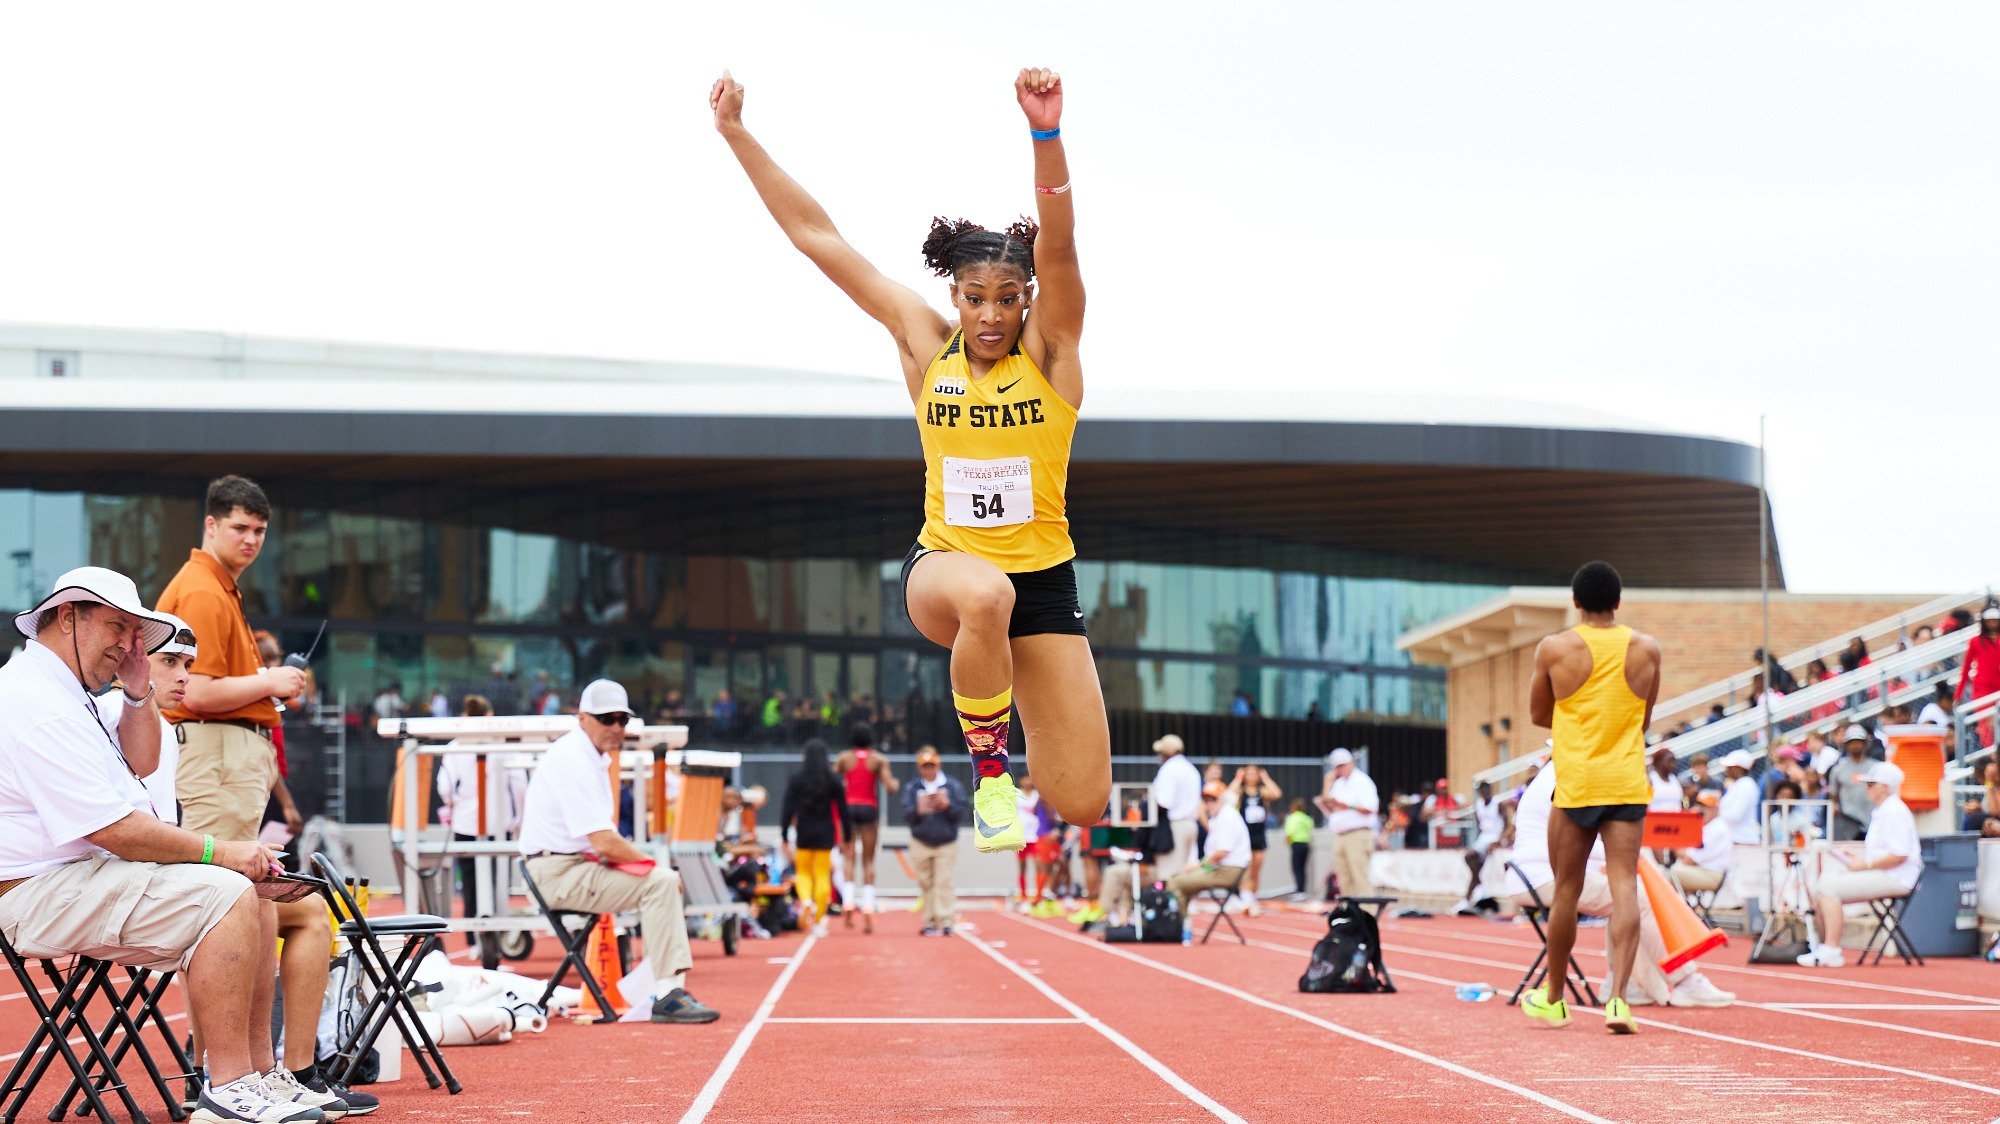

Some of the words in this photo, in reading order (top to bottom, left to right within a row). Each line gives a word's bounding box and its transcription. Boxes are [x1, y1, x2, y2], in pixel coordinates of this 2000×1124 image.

[927, 402, 960, 427] APP
[970, 398, 1044, 427] STATE
[964, 471, 992, 479] TEXAS
[994, 469, 1029, 478] RELAYS
[972, 494, 1004, 519] 54
